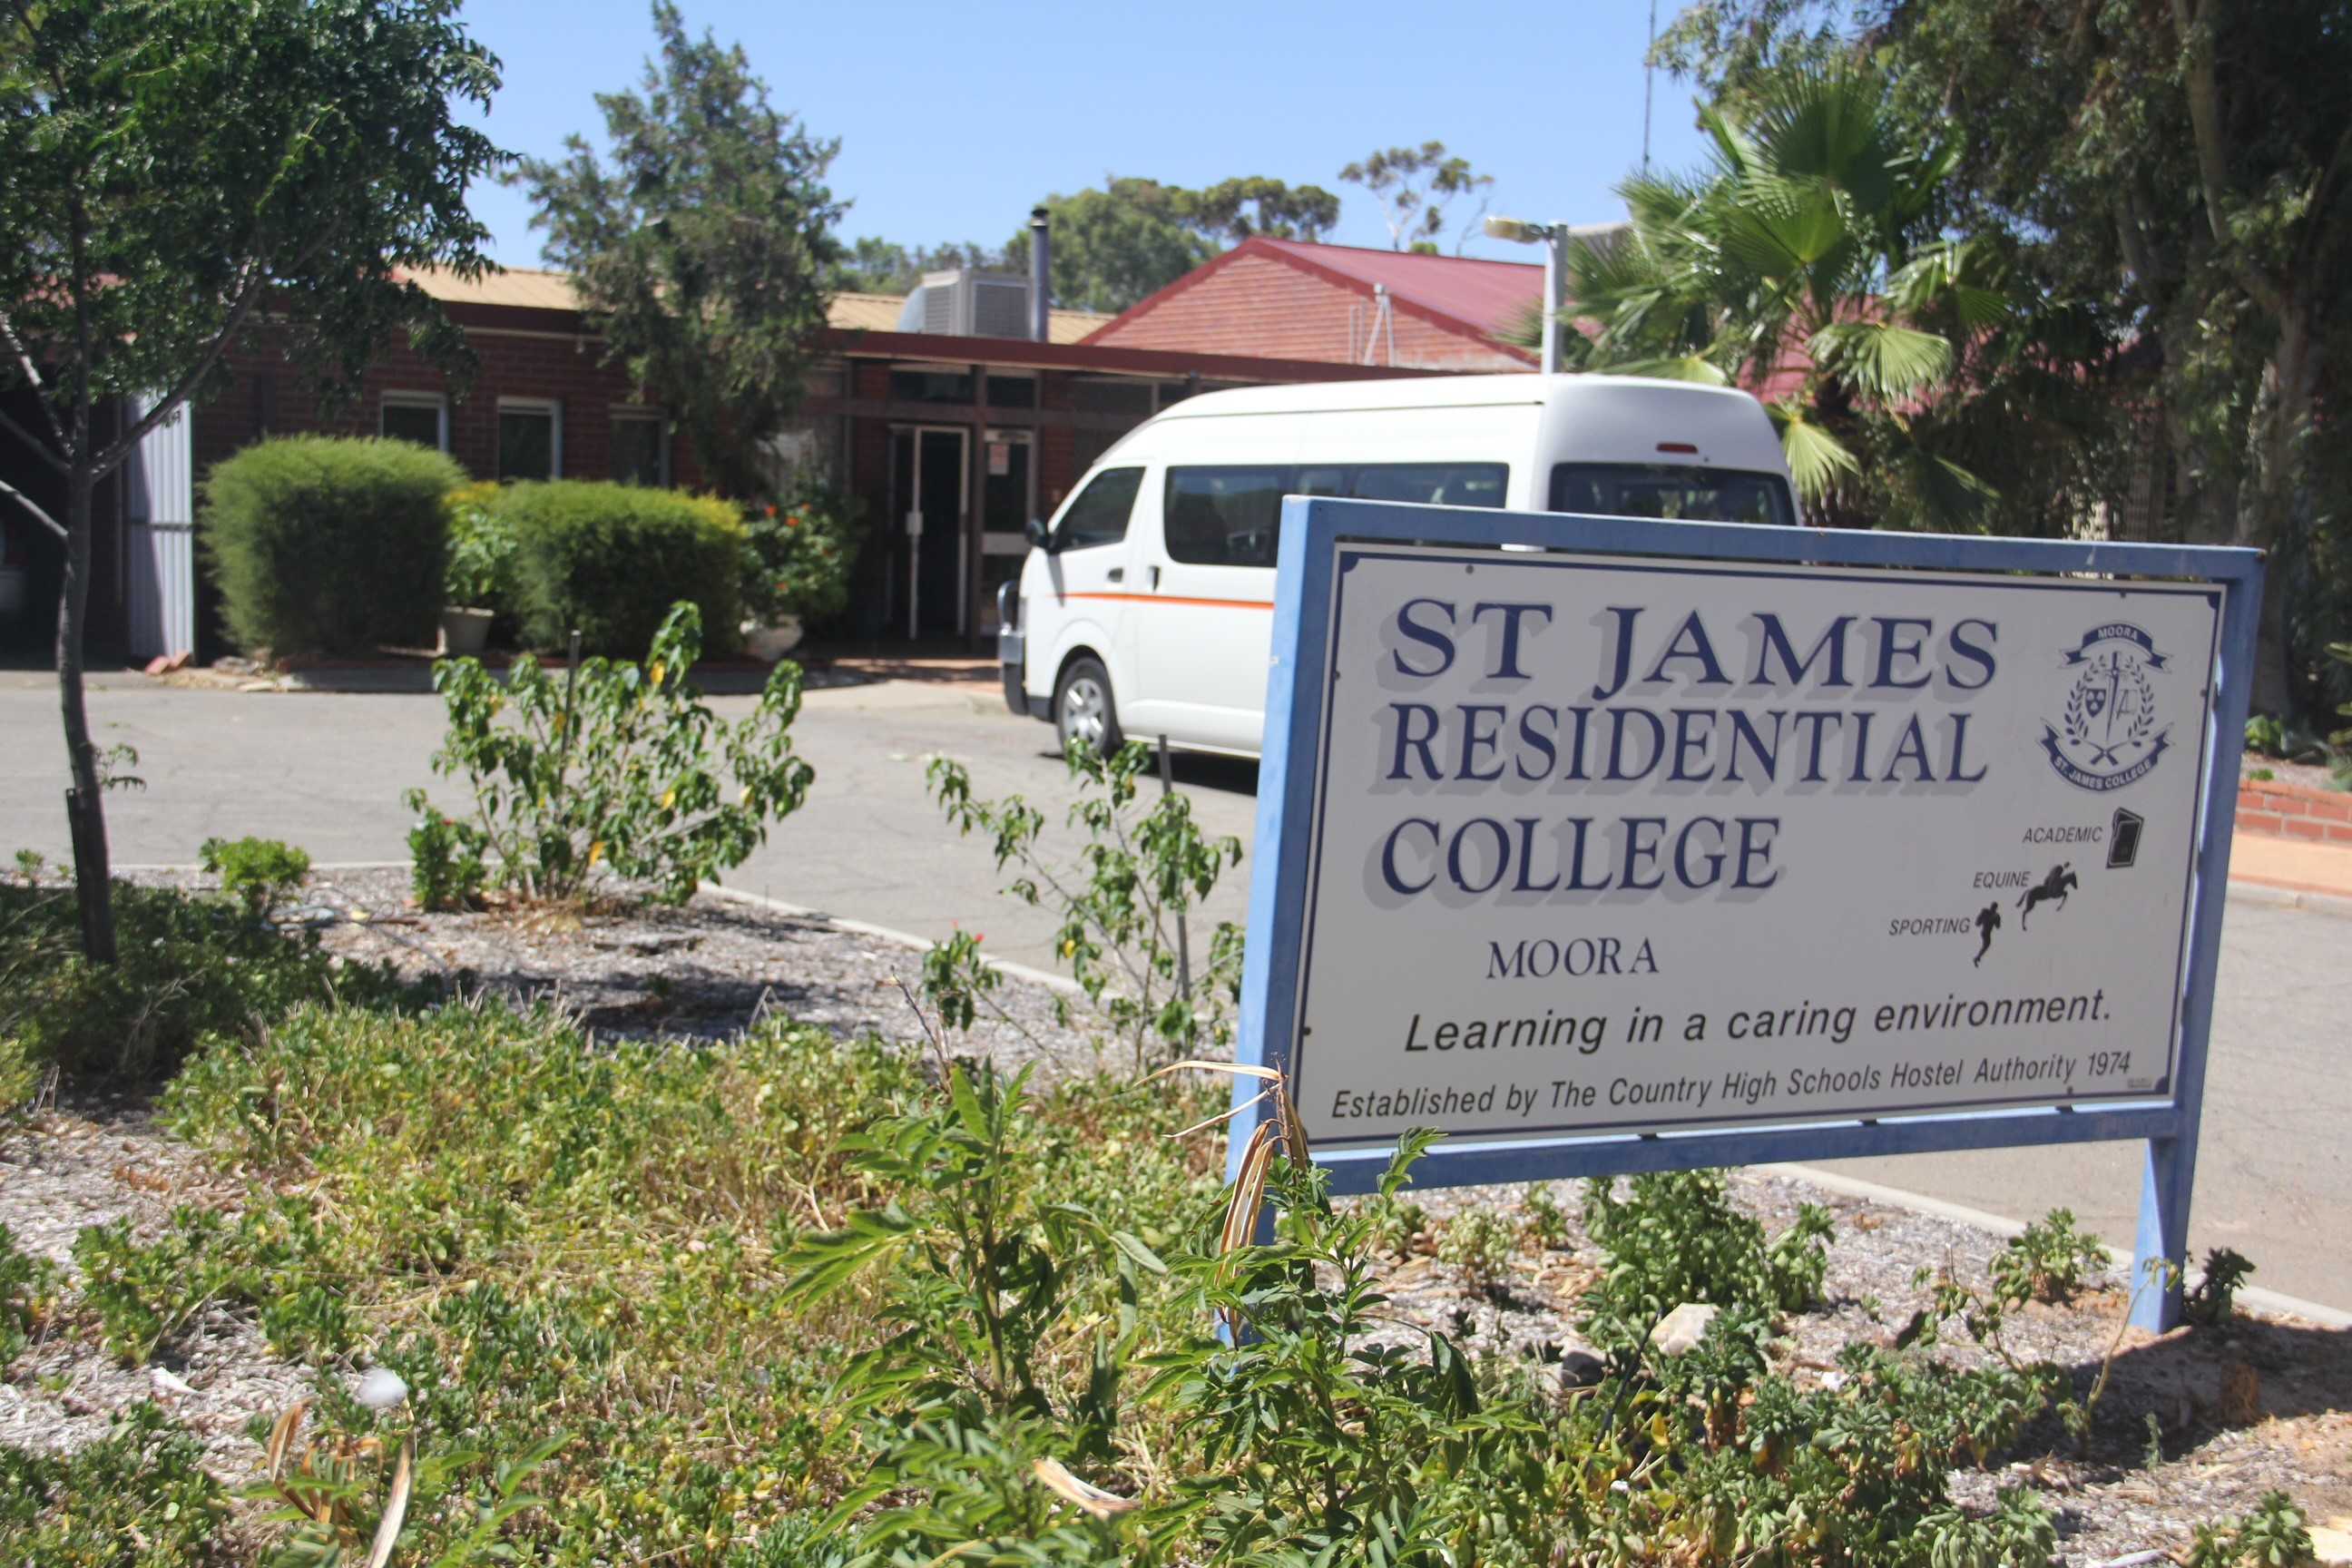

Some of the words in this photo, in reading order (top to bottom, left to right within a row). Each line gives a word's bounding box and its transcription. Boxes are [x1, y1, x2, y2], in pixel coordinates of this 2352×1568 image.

[1394, 598, 1553, 679] ST
[1592, 605, 1998, 701] JAMES
[2098, 626, 2138, 642] MOORA
[1386, 702, 1987, 785] RESIDENTIAL
[2068, 769, 2103, 790] JAMES
[2105, 759, 2152, 789] COLLEGE
[1381, 816, 1780, 896] COLLEGE
[2023, 827, 2103, 844] ACADEMIC
[1973, 871, 2032, 889] EQUINE
[1889, 918, 1971, 936] SPORTING
[1485, 936, 1660, 979] MOORA
[1405, 1009, 1608, 1055] Learning
[1626, 1006, 1664, 1044] in
[1683, 1012, 1707, 1041] a
[1727, 1000, 1857, 1044] caring
[1874, 988, 2112, 1033] environment.
[1331, 1084, 1495, 1119] Established
[1505, 1083, 1538, 1117] by
[1551, 1081, 1597, 1109] The
[1609, 1075, 1712, 1107] Country
[1722, 1070, 1777, 1104] High
[1787, 1064, 1881, 1096] Schools
[1890, 1059, 1965, 1089] Hostel
[1974, 1054, 2077, 1084] Authority
[2087, 1050, 2132, 1076] 1974
